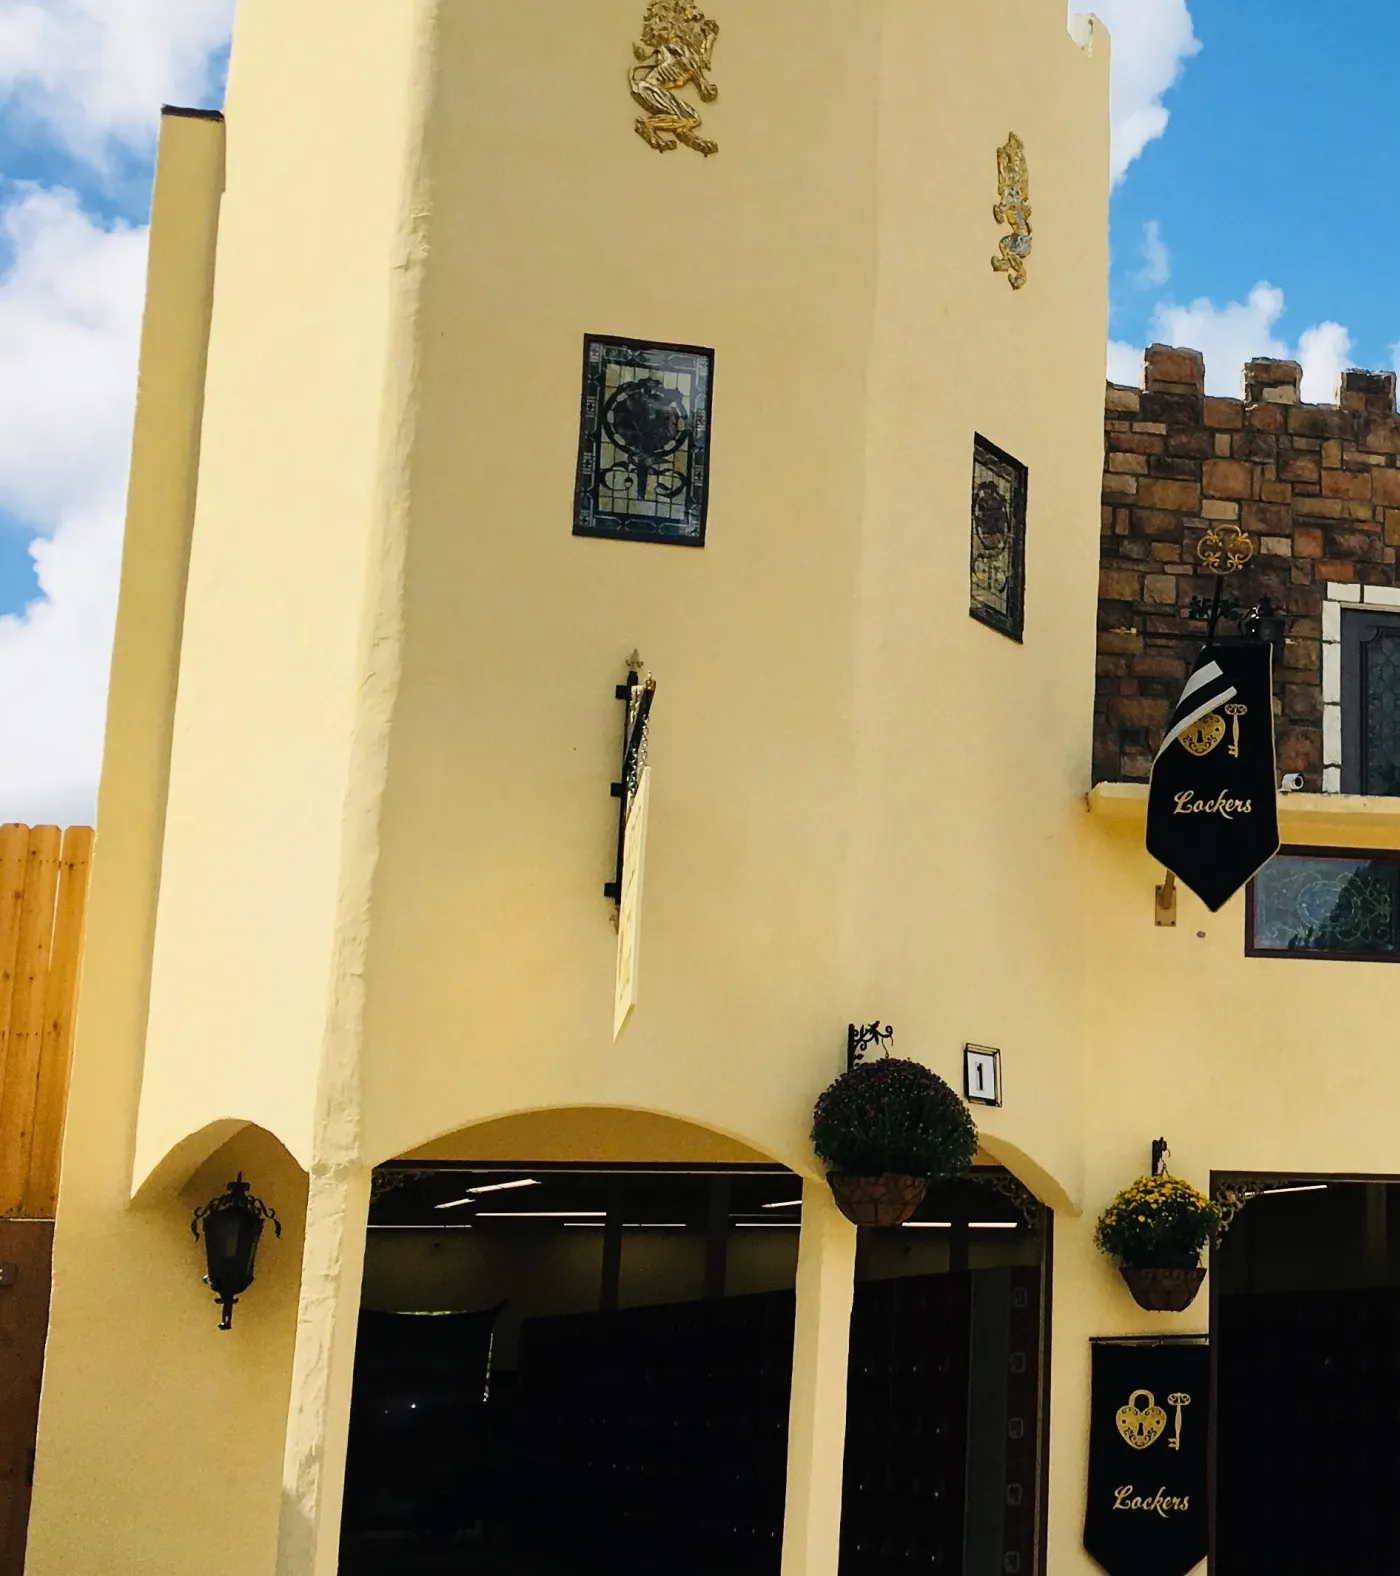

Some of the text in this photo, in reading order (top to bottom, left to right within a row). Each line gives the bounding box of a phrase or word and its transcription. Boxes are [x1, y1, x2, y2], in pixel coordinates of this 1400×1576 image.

[1173, 789, 1252, 819] Lockers
[976, 1062, 984, 1091] 1
[1112, 1485, 1189, 1518] Lockers
